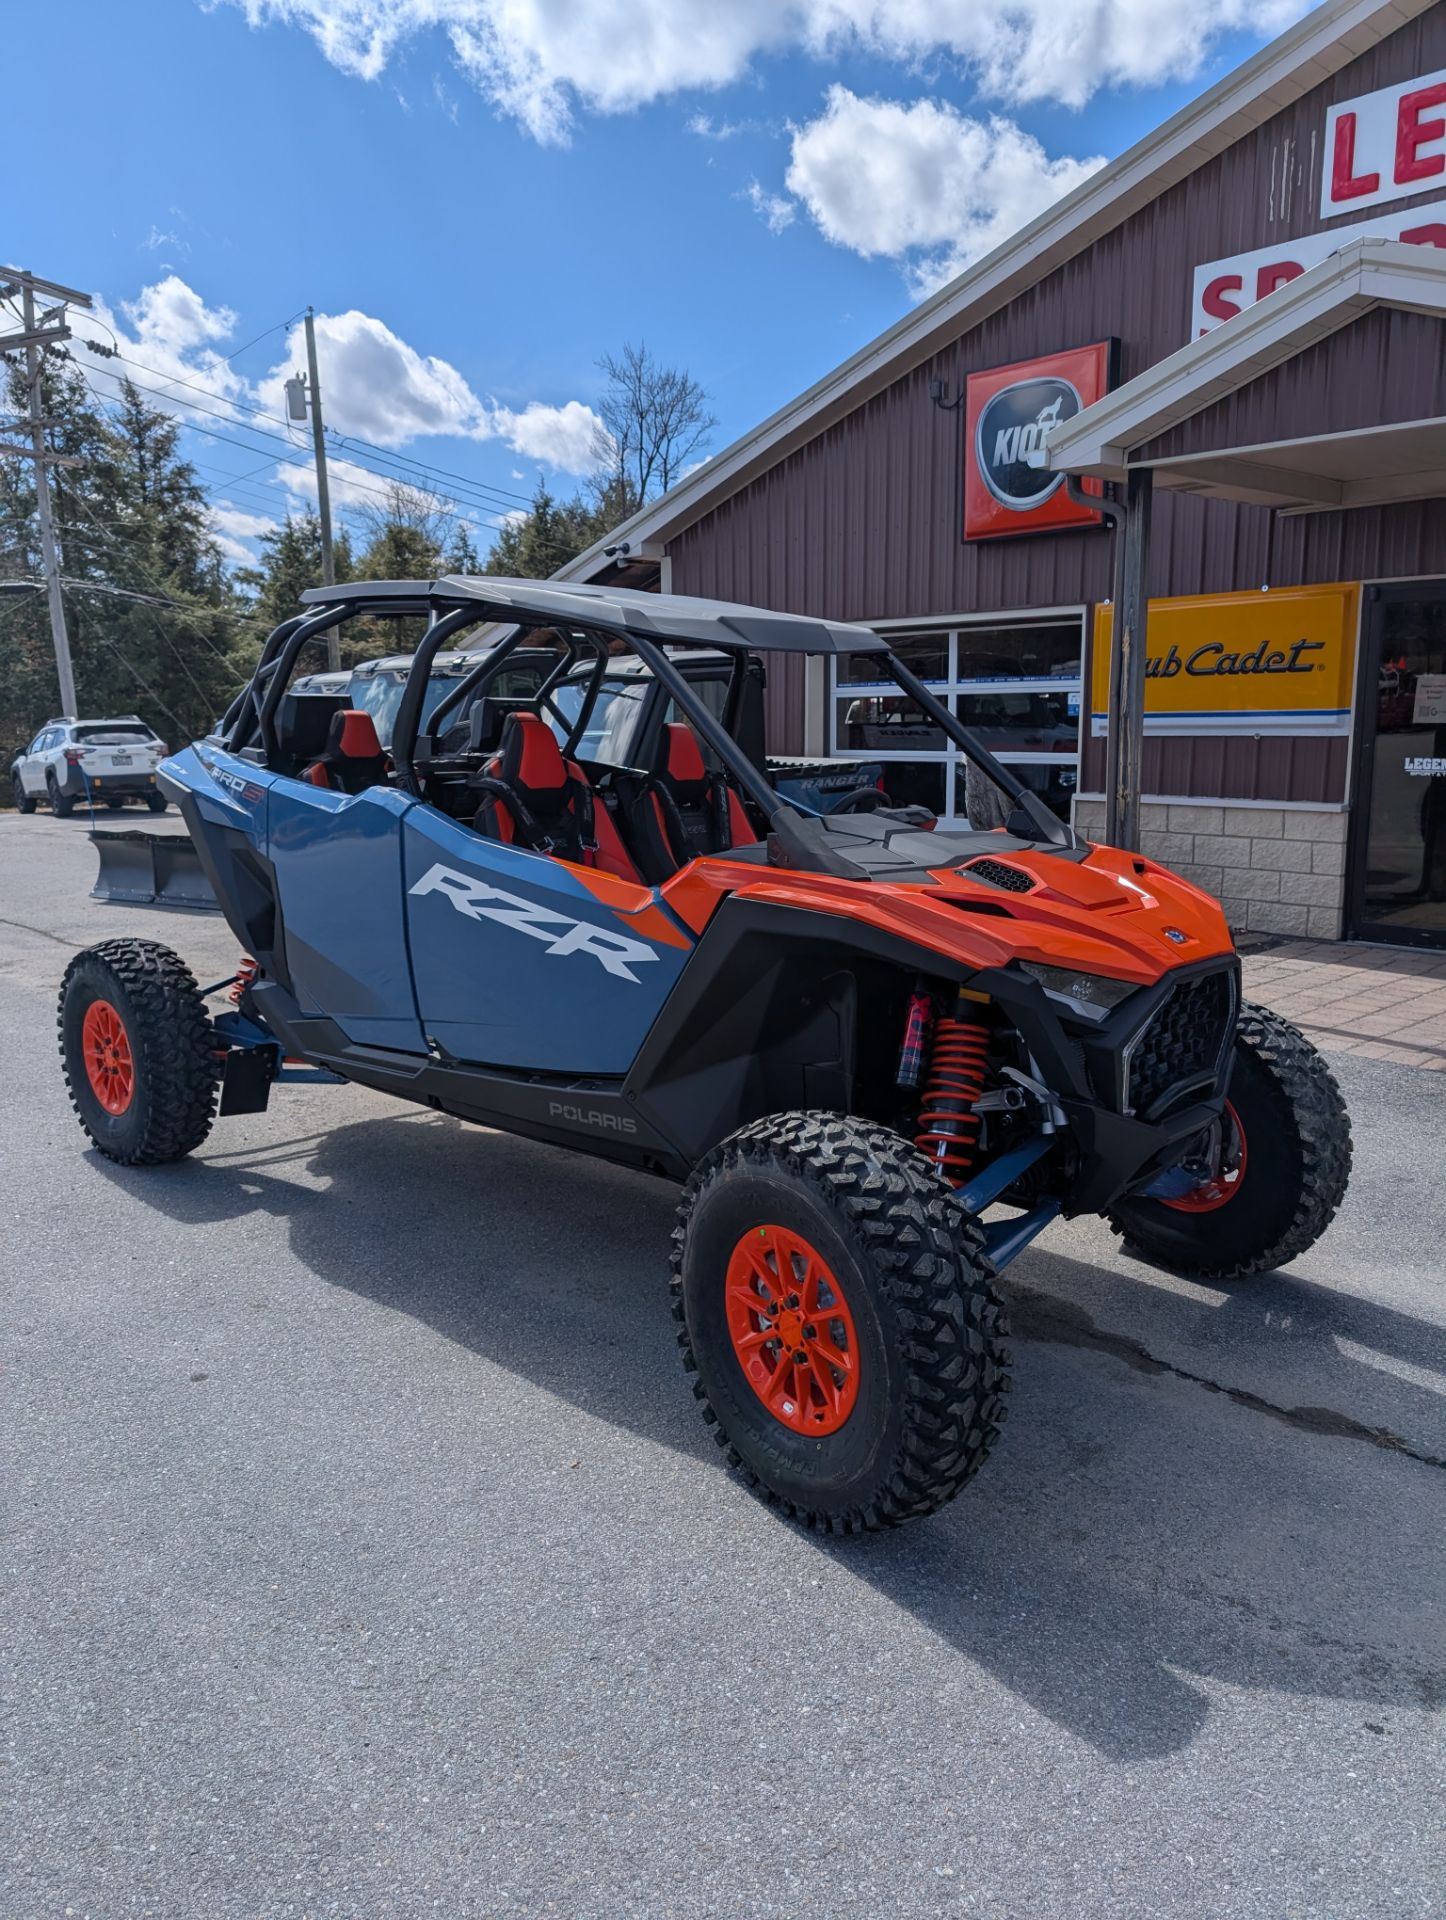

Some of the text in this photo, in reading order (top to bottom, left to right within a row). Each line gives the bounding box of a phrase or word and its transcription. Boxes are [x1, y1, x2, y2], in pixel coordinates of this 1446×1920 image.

[992, 419, 1065, 467] KIOT
[1145, 638, 1326, 678] ub Cadet
[210, 766, 247, 793] PRO
[801, 775, 869, 790] RANGER
[408, 863, 660, 984] RZR
[548, 1102, 637, 1134] POLARIS
